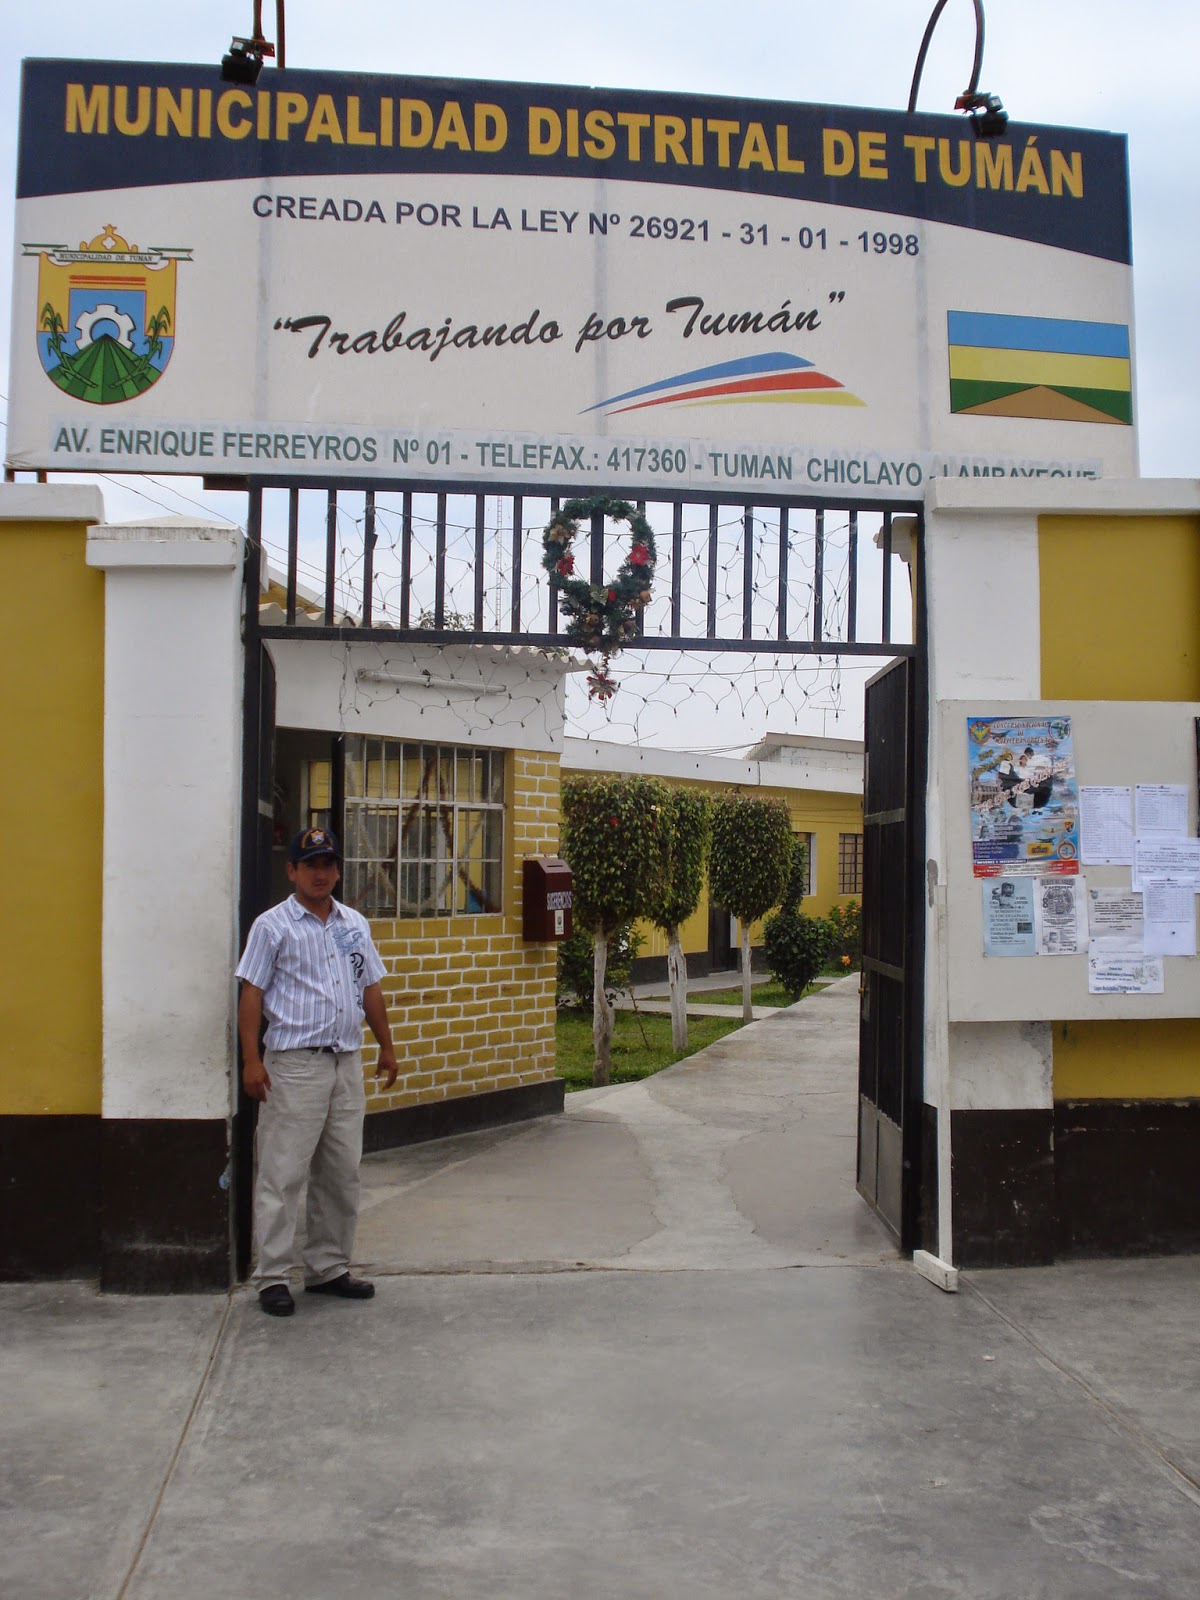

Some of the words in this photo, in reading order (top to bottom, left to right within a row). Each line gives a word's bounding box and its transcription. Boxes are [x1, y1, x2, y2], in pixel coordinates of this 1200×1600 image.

[65, 84, 508, 152] MUNICIPALIDAD
[528, 106, 805, 174] DISTRITAL
[822, 128, 889, 180] DE
[904, 135, 1084, 198] TUMÁN
[253, 194, 387, 224] CREADA
[395, 201, 462, 228] POR
[472, 206, 512, 231] LA
[521, 208, 580, 234] LEY
[629, 215, 709, 242] 26921
[739, 222, 768, 246] 31
[798, 226, 827, 250] 01
[857, 231, 920, 257] 1998
[59, 253, 112, 261] MUNICIPALIDAD
[574, 310, 653, 353] por
[54, 427, 91, 454] AV.
[100, 429, 214, 458] ENRIQUE
[223, 432, 377, 463] FERREYROS
[426, 440, 451, 466] 01
[607, 447, 687, 474] 417360
[709, 452, 793, 481] TUMAN
[807, 457, 923, 487] CHICLAYO
